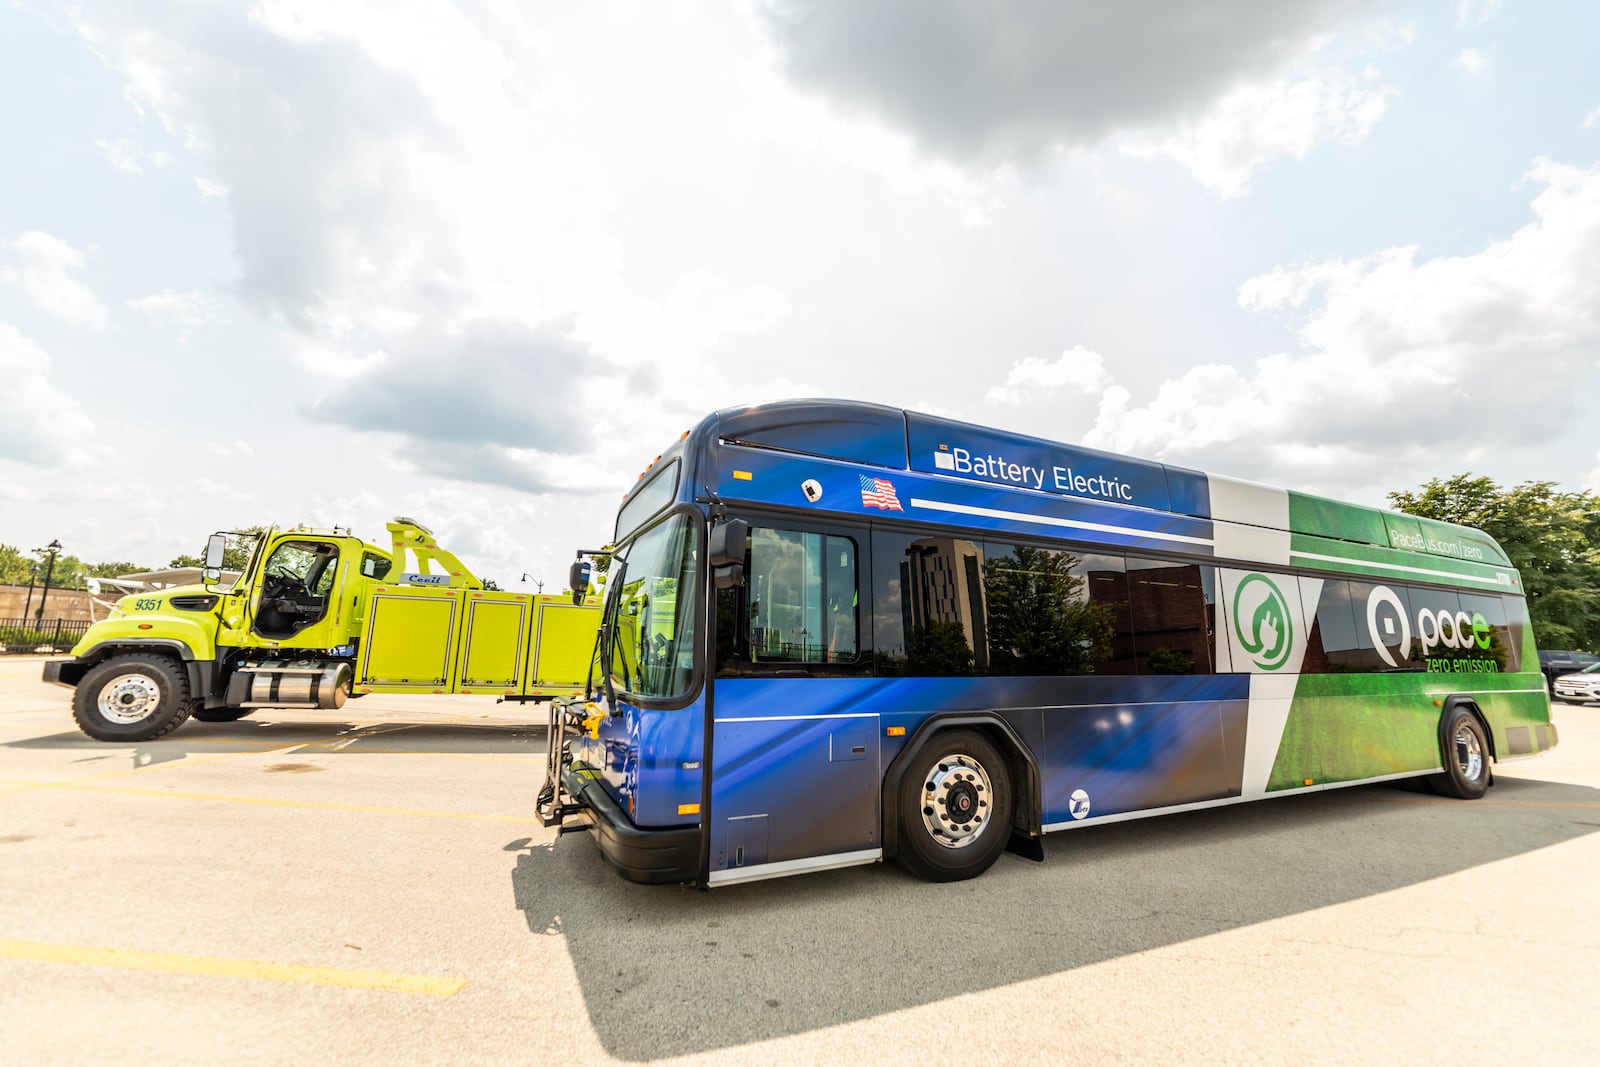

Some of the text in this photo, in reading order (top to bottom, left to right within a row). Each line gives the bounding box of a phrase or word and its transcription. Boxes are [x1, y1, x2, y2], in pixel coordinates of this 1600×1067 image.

[953, 447, 1133, 500] Battery Electric
[135, 598, 163, 611] 9351
[1418, 607, 1491, 656] pace
[1425, 655, 1498, 673] zero emission
